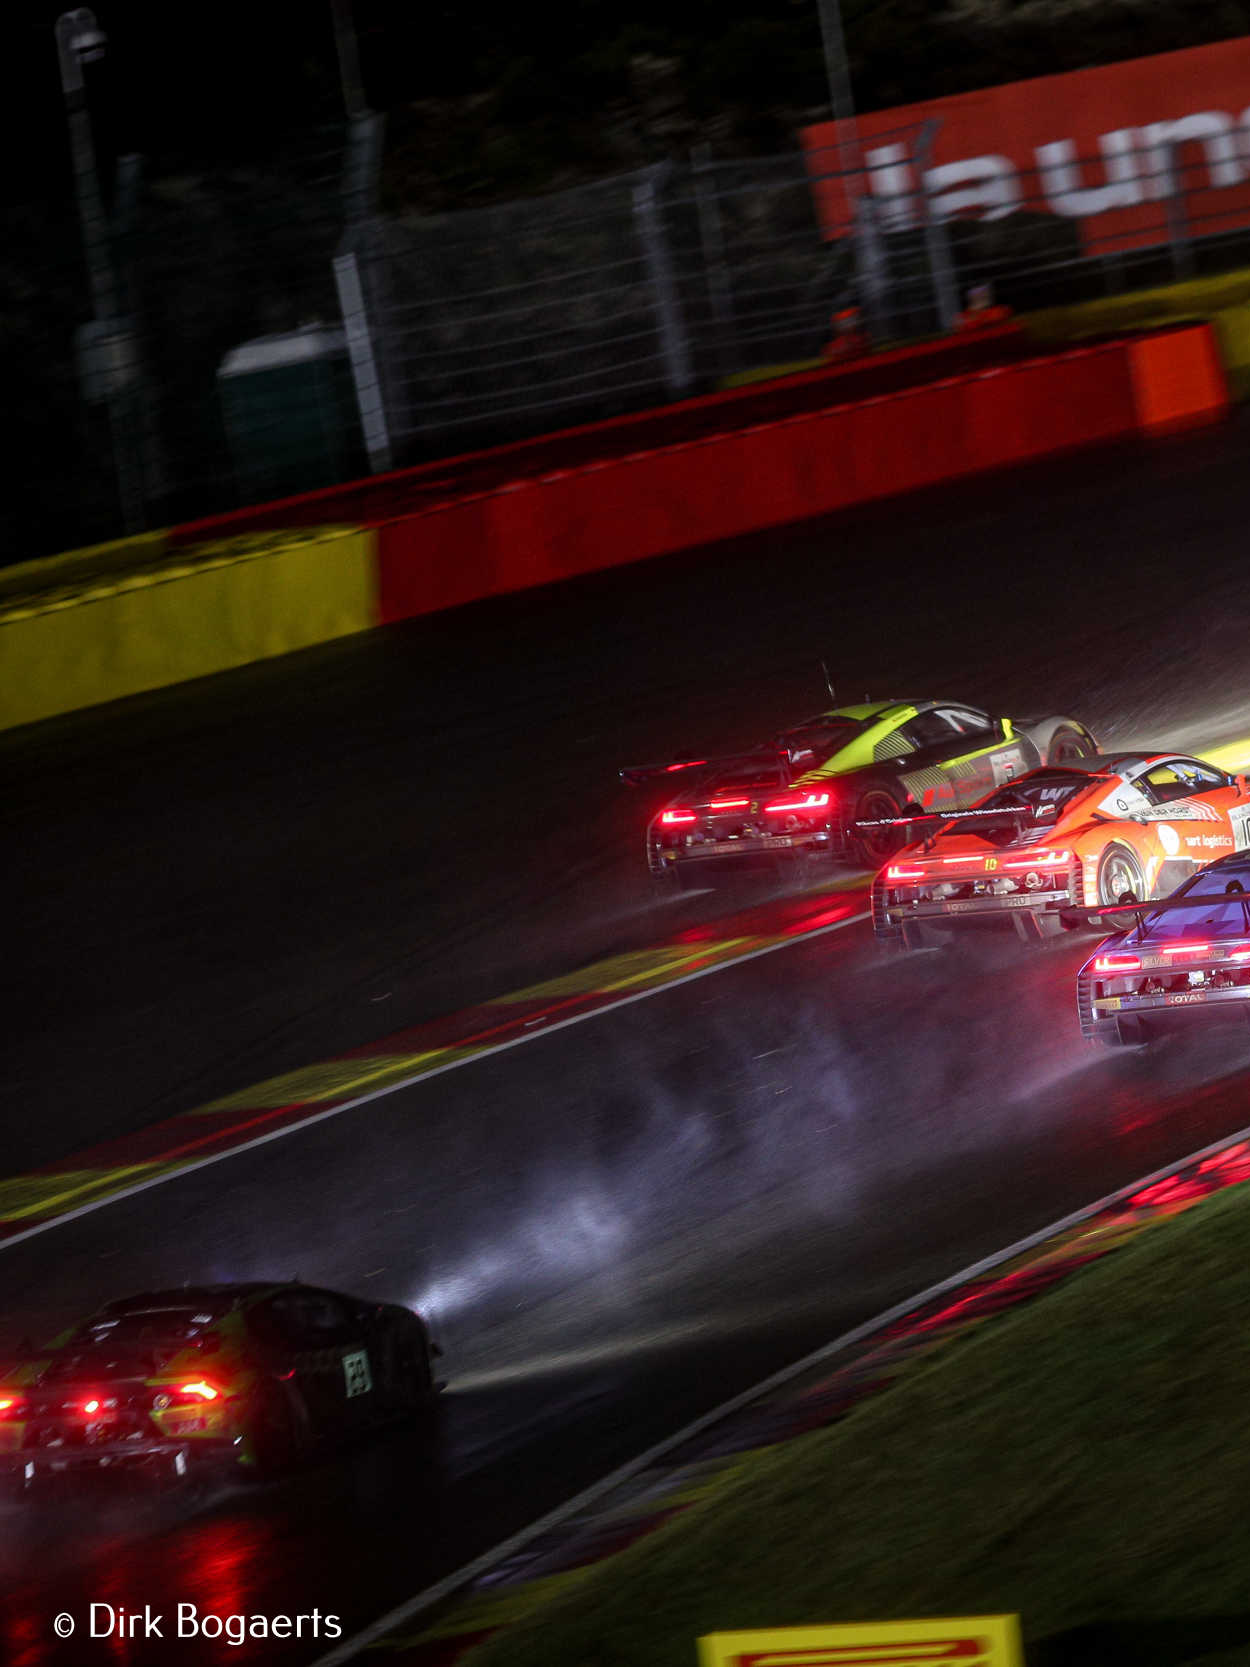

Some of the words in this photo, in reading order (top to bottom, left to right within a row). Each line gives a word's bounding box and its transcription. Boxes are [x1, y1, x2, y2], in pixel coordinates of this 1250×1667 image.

[750, 802, 759, 814] 2
[1203, 834, 1233, 848] logistics
[985, 858, 997, 872] 10
